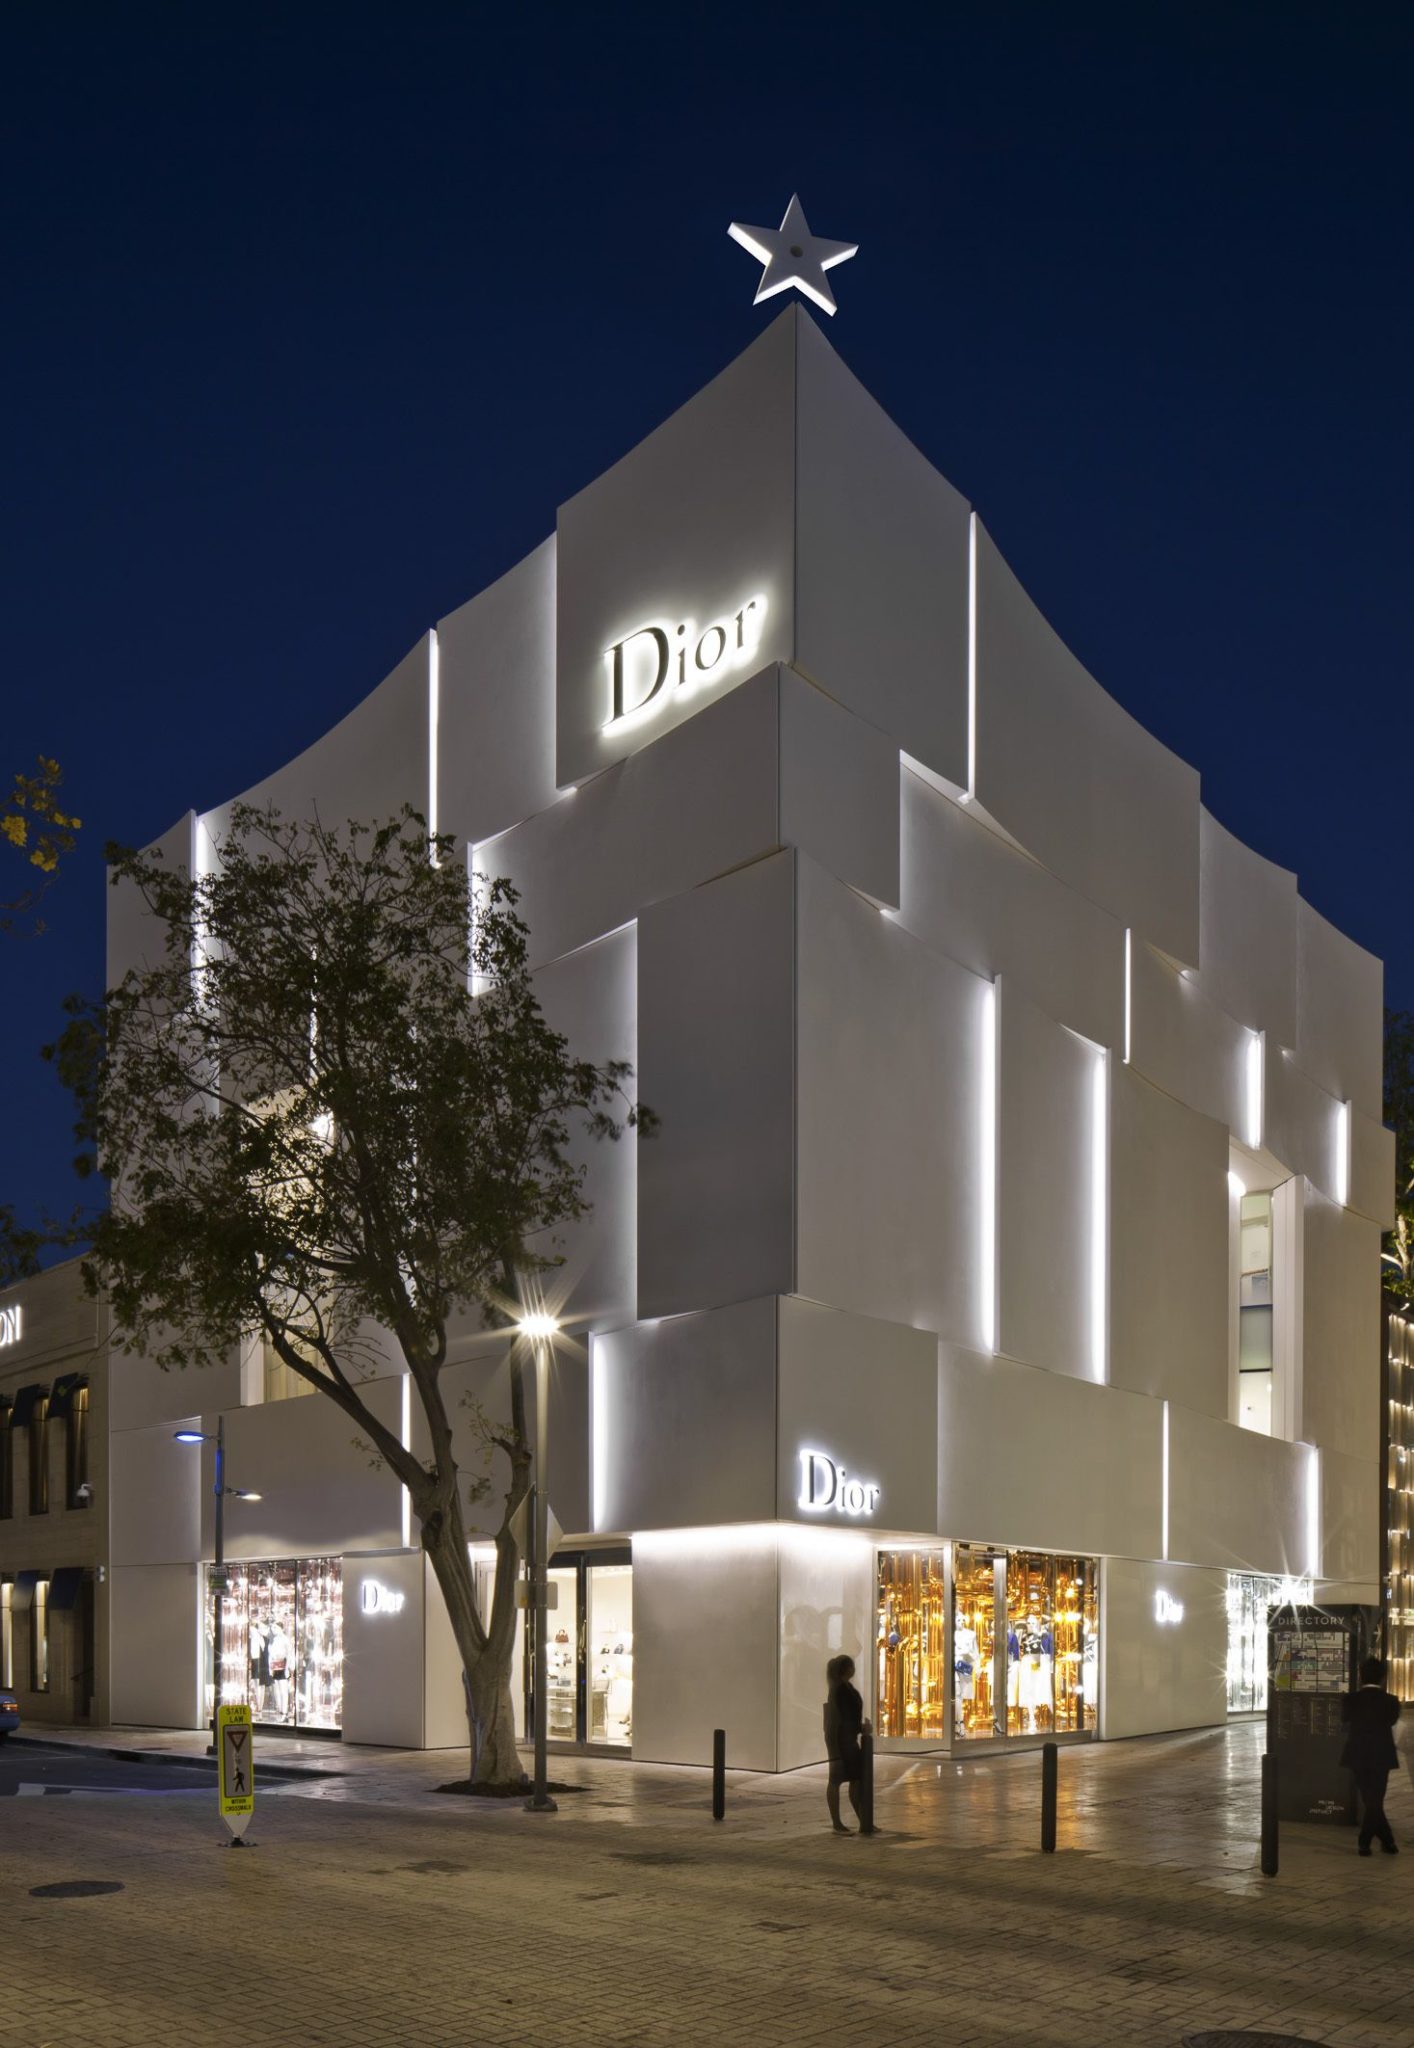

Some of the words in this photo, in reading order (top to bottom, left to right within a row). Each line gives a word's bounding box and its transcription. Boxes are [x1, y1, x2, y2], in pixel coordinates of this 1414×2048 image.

[601, 599, 758, 730] Dior
[800, 1453, 881, 1511] Dior
[1278, 1616, 1345, 1626] DIRECTORY
[225, 1707, 247, 1715] STATE
